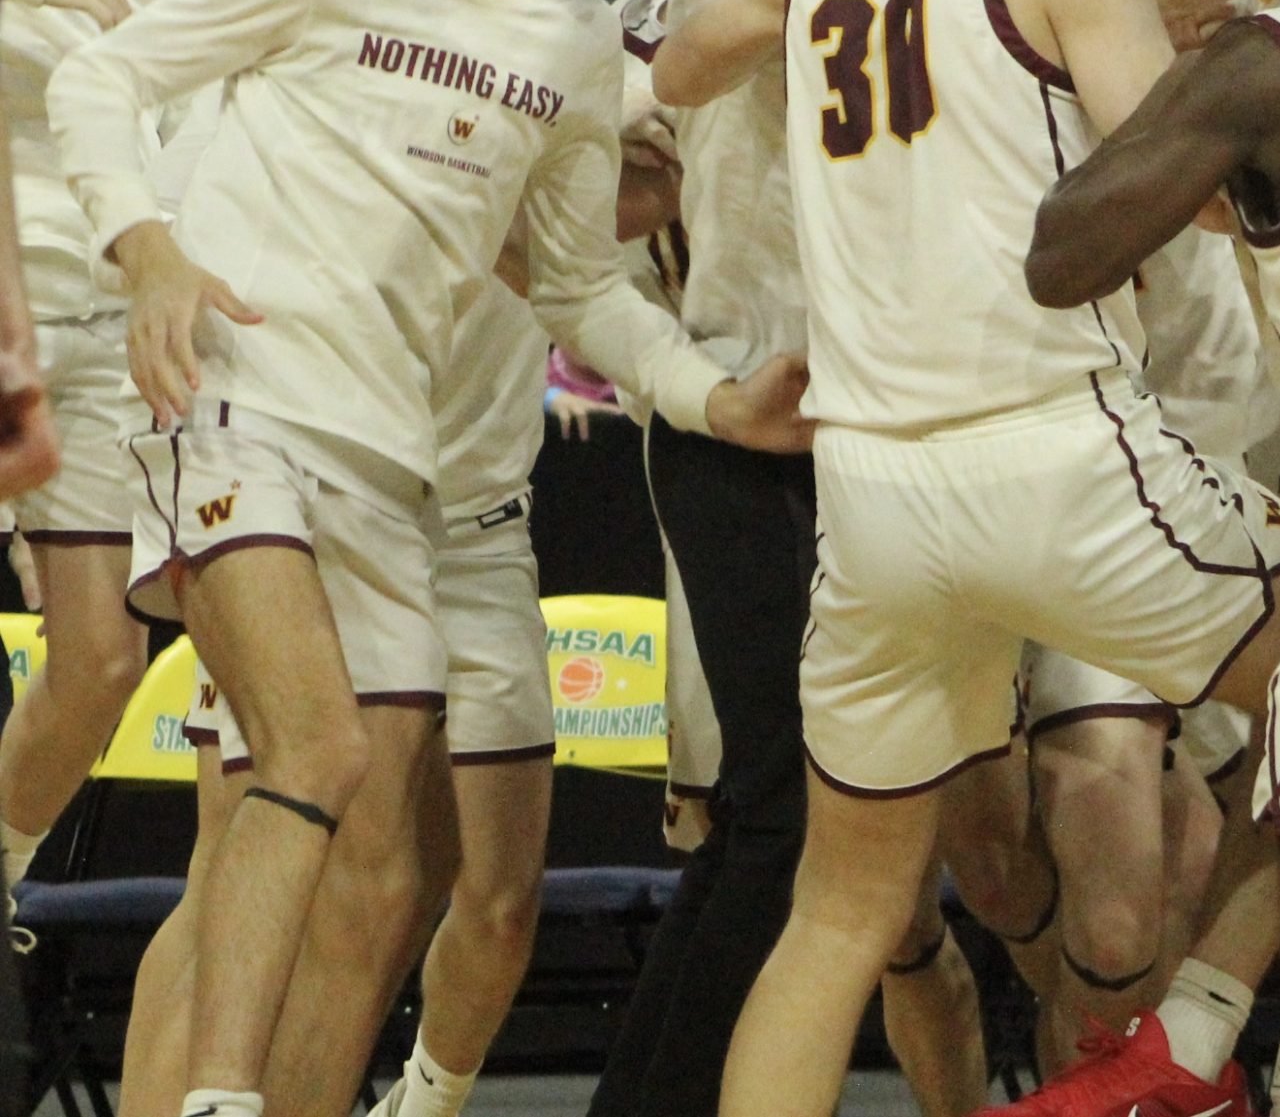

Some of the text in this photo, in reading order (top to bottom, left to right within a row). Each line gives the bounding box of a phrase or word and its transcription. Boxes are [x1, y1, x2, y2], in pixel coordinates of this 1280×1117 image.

[357, 32, 565, 128] NOTHING EASY.
[453, 117, 476, 140] W
[406, 144, 446, 166] WINDSOR
[196, 493, 235, 530] W
[546, 629, 653, 664] HSAA
[152, 714, 193, 751] STA
[554, 703, 667, 737] AMPIONSHIPS
